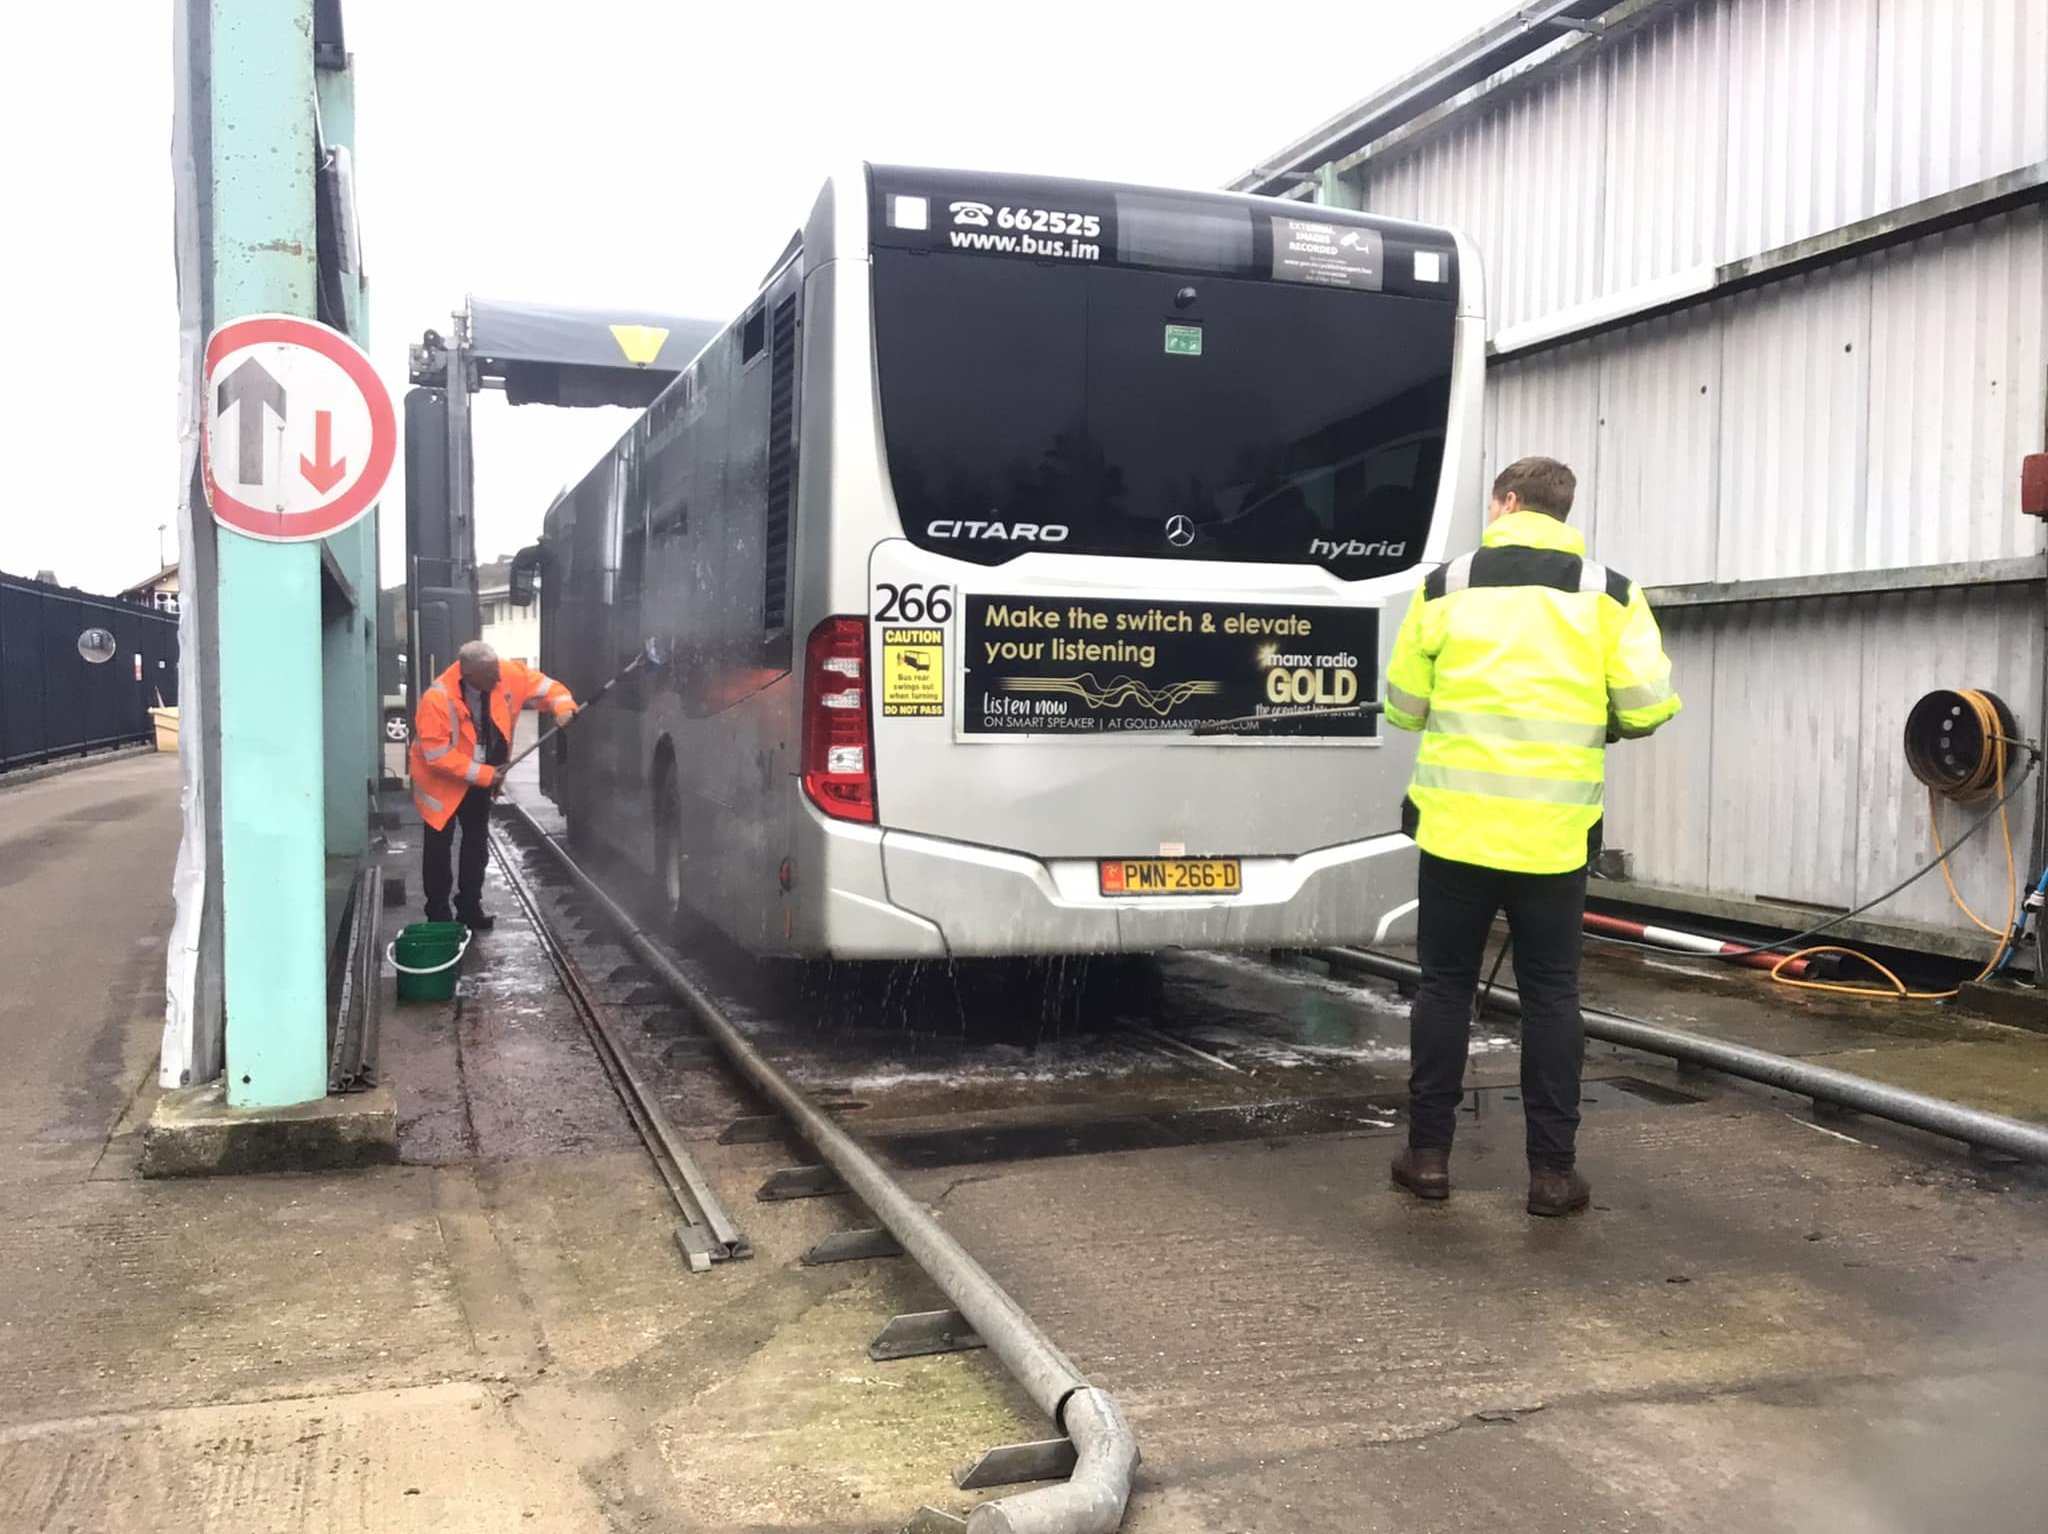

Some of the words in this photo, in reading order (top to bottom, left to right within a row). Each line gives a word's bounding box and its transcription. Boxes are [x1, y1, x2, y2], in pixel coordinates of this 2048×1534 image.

[996, 206, 1101, 237] 662525
[1289, 221, 1336, 236] EXTERNAL
[949, 230, 1100, 261] www.bus.im
[1295, 231, 1331, 245] IMAGES
[1288, 241, 1338, 256] RECORDED
[926, 519, 1070, 543] CITARO
[1309, 537, 1406, 560] hybrid
[874, 582, 952, 624] 266
[984, 604, 1061, 629] Make
[1067, 607, 1109, 631] the
[1115, 609, 1193, 633] switch
[1200, 612, 1217, 634] &
[1223, 612, 1312, 636] elevate
[885, 629, 942, 644] CAUTION
[984, 640, 1044, 664] your
[1051, 637, 1156, 668] listening
[1266, 653, 1313, 668] manx
[1315, 652, 1358, 668] radio
[897, 673, 912, 682] Bus
[914, 674, 930, 682] rear
[893, 683, 920, 692] swings
[1265, 667, 1359, 705] GOLD
[889, 692, 910, 700] when
[911, 692, 939, 701] turning
[983, 691, 1030, 715] Listen
[1034, 702, 1068, 716] now
[884, 704, 898, 715] DO
[900, 704, 918, 715] NOT
[920, 704, 943, 715] PASS
[983, 716, 1004, 728] ON
[1006, 716, 1044, 729] SMART
[1047, 717, 1095, 729] SPEAKER
[1107, 718, 1122, 730] AT
